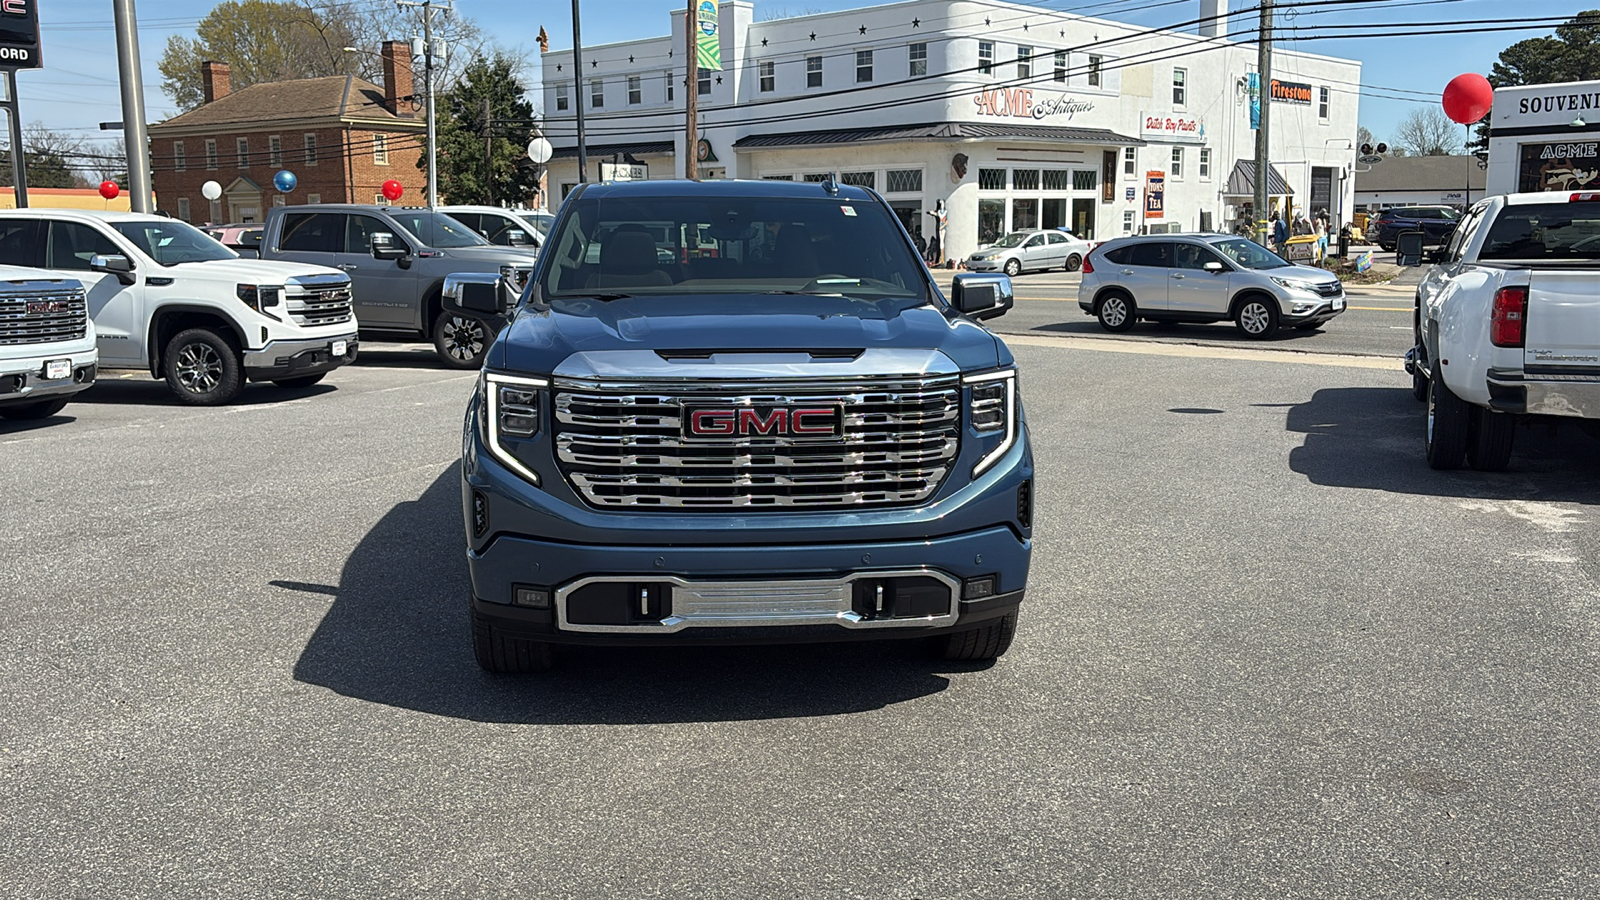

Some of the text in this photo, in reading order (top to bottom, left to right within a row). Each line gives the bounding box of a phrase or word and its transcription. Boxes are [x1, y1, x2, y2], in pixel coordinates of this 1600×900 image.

[0, 47, 28, 60] ORD
[1271, 80, 1311, 101] Firestone
[973, 87, 1033, 118] ACME
[1146, 117, 1197, 133] Dutch Boy Paints
[1540, 143, 1598, 159] ACME
[1149, 197, 1162, 209] TEA
[28, 302, 68, 313] GMC
[691, 408, 835, 434] GMC
